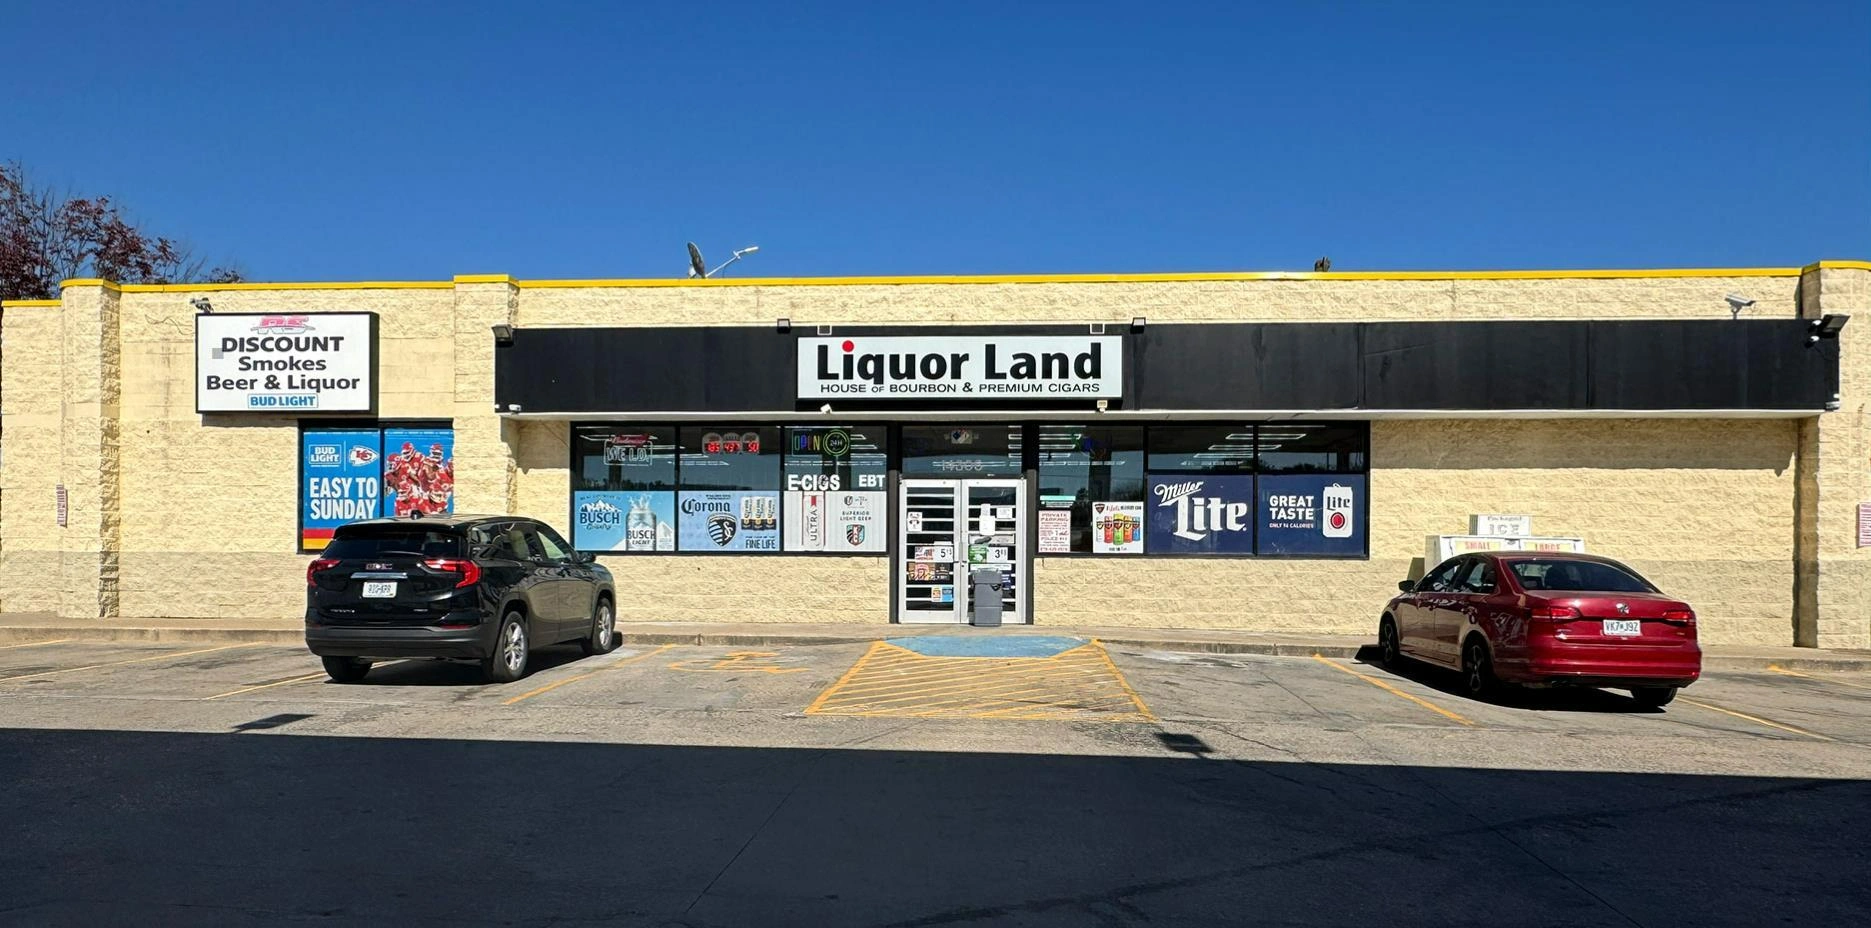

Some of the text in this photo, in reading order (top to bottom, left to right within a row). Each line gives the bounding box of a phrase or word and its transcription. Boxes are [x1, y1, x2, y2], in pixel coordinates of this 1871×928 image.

[222, 336, 344, 352] DISCOUNT
[238, 356, 326, 371] Smokes
[817, 340, 1102, 384] Liquor Land
[206, 374, 360, 392] Beer & Liquor
[820, 384, 866, 393] HOUSE
[890, 384, 956, 393] BOURBON
[962, 382, 974, 393] &
[979, 384, 1042, 393] PREMIUM
[1048, 383, 1100, 393] CIGARS
[250, 396, 316, 406] BUD LIGHT
[314, 446, 336, 454] BUD
[310, 454, 340, 462] LIGHT
[310, 477, 378, 498] EASY TO
[858, 474, 886, 488] EBT
[1154, 481, 1204, 506] Miller
[681, 498, 730, 516] Corona
[1270, 495, 1314, 507] GREAT
[1327, 496, 1350, 511] Lite
[310, 499, 376, 520] SUNDAY
[1270, 508, 1314, 520] TASTE
[580, 512, 620, 524] BUSCH
[1173, 494, 1248, 541] Lite
[810, 509, 818, 541] ULTRA
[1489, 524, 1520, 535] ICE
[627, 530, 656, 540] BUSCH
[745, 540, 776, 549] FINE LIFE
[1465, 542, 1490, 550] SMALL
